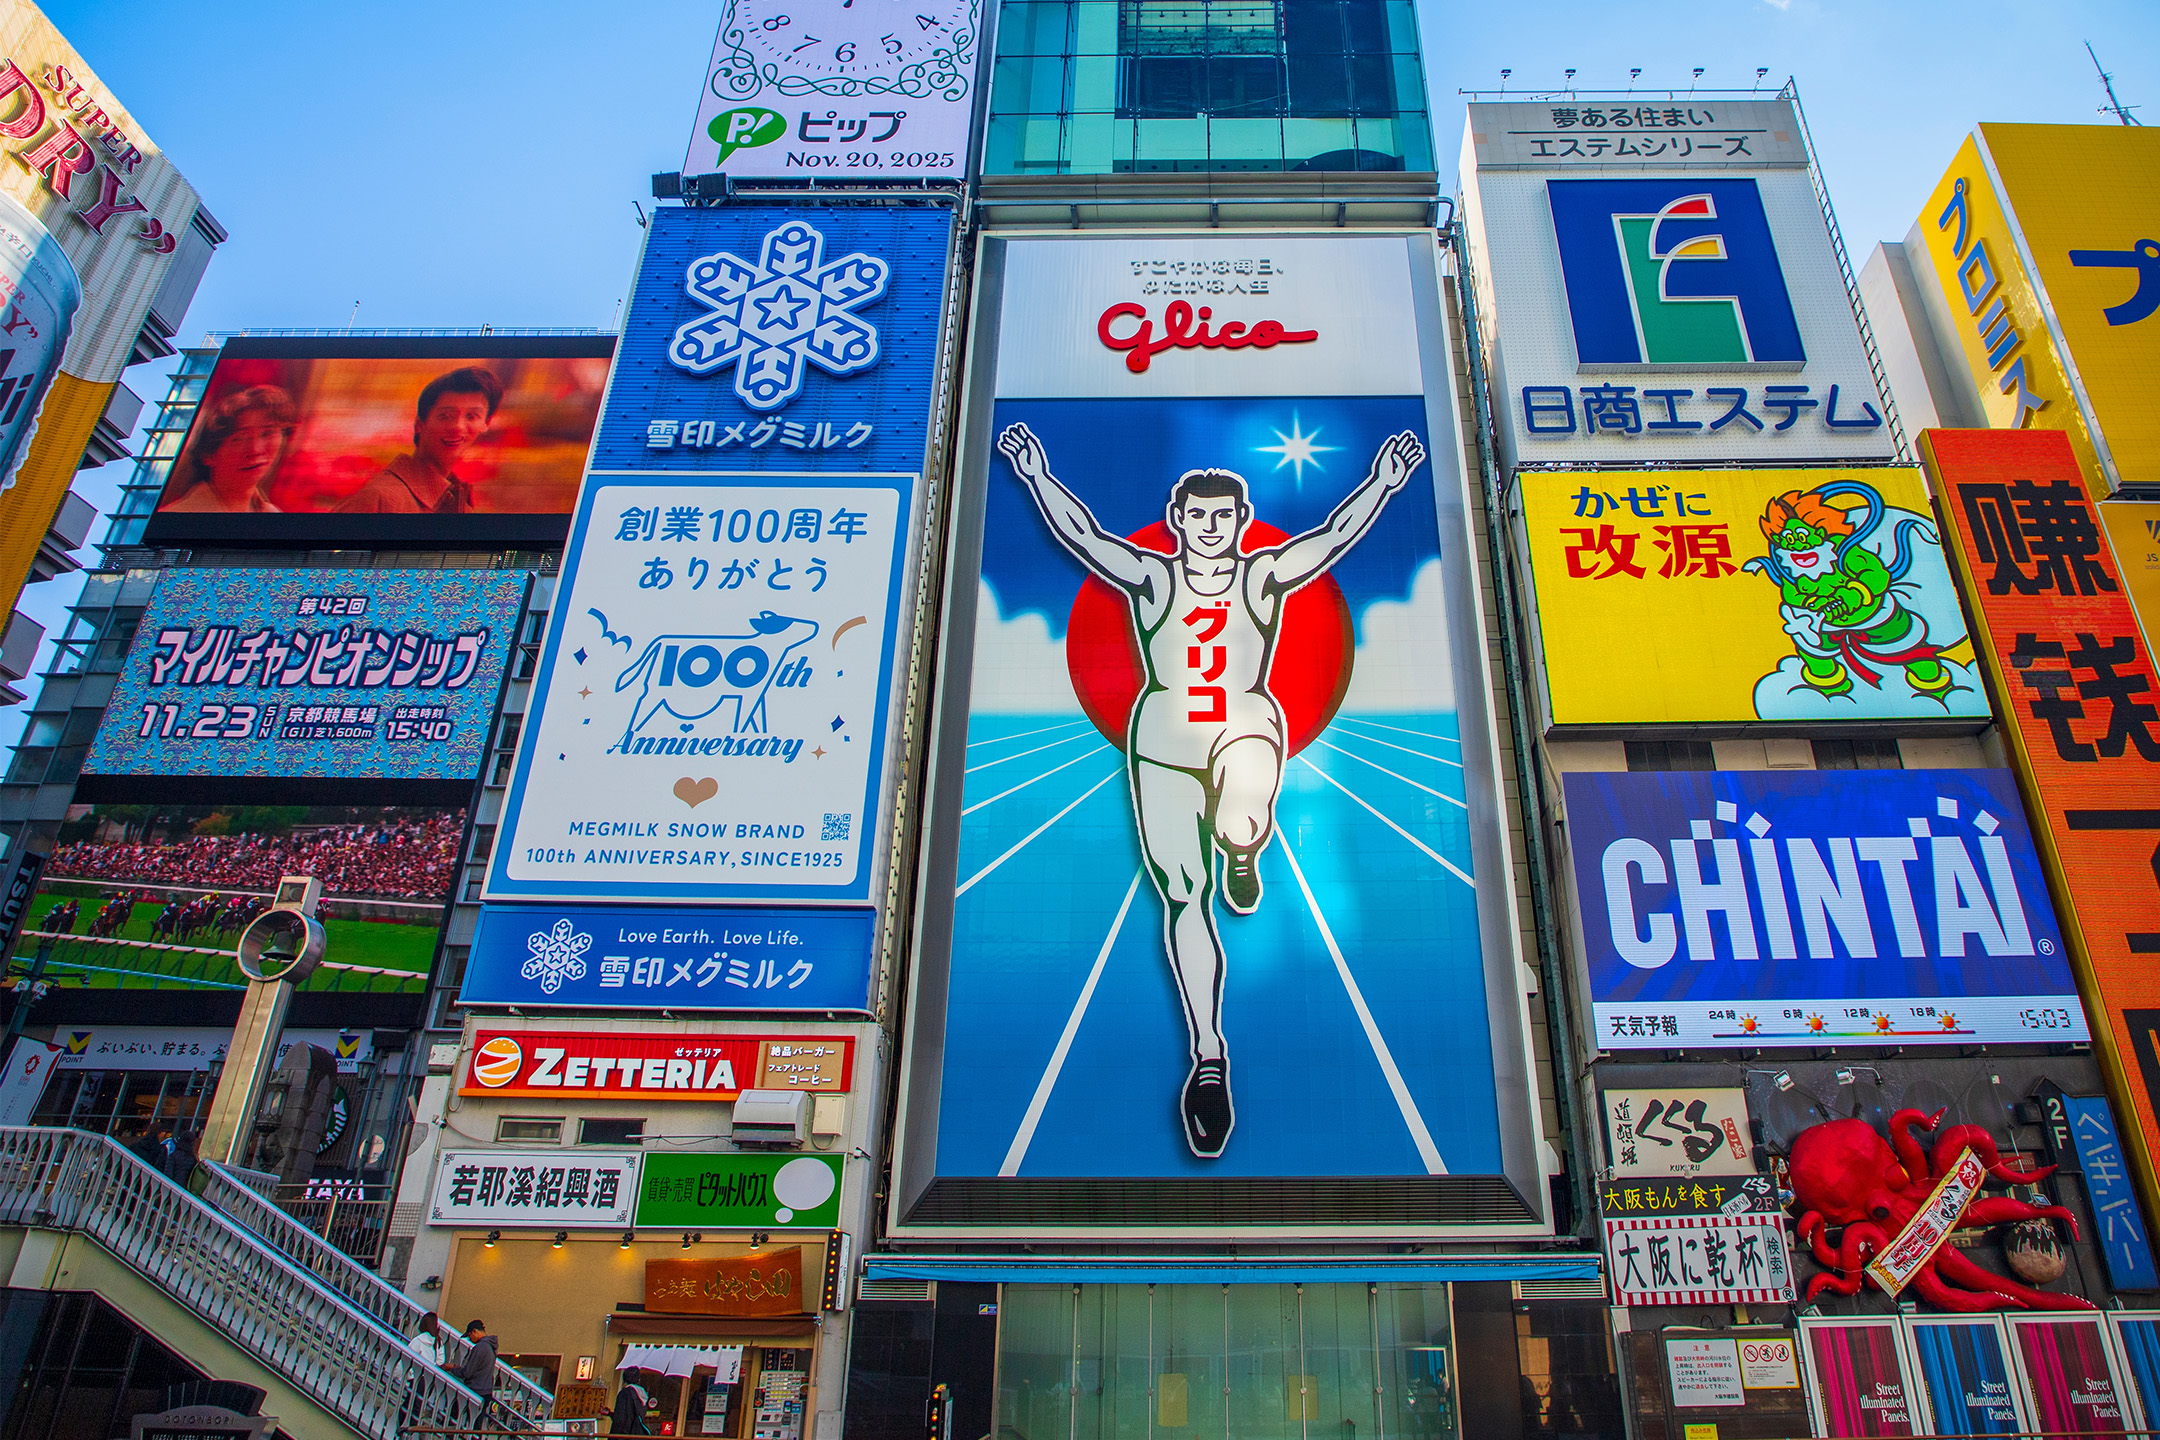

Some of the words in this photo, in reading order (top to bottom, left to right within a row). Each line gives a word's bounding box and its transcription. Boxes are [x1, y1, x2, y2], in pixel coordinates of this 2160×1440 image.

[762, 15, 791, 31] 8
[916, 14, 940, 31] 4
[793, 34, 822, 53] 7
[881, 33, 903, 54] 5
[835, 43, 856, 62] 6
[44, 64, 142, 175] SUPER
[798, 110, 907, 143] ピップ
[1551, 107, 1714, 129] 夢ある住まい
[1530, 135, 1752, 158] エステムシリーズ
[785, 152, 839, 168] Nov.
[846, 152, 884, 169] 20,
[890, 152, 955, 168] 2025
[1130, 259, 1284, 276] すこやかな毎日、
[1142, 280, 1270, 295] ゆたかな人生
[1938, 177, 2048, 429] プロミス
[1522, 383, 1883, 435] 日商エステム
[646, 416, 874, 451] 雪印メグミルク
[1571, 484, 1712, 519] かぜに
[614, 505, 868, 544] 創業100周年
[1559, 522, 1739, 581] 改源
[638, 556, 828, 592] ありがとう
[298, 597, 367, 615] 第42回
[153, 627, 487, 688] マイルチャンピオンシップ
[658, 643, 814, 689] 100th
[1182, 601, 1232, 723] グリコ
[140, 704, 257, 738] 11.23
[258, 705, 277, 738] SUN
[286, 706, 378, 724] 京都競馬場
[395, 707, 445, 719] 出走時刻
[388, 721, 452, 740] 15:40
[606, 729, 805, 764] Anniversary
[568, 821, 658, 837] MEGMILK
[667, 822, 728, 838] SNOW
[735, 823, 806, 840] BRAND
[526, 848, 576, 864] 100th
[618, 928, 657, 943] Love
[662, 928, 715, 944] Earth.
[723, 929, 763, 945] Love
[767, 930, 804, 946] Life.
[600, 952, 814, 989] 雪印メグミルク
[1708, 1010, 1736, 1020] 24時
[1783, 1009, 1803, 1019] 6時
[1843, 1008, 1870, 1018] 12時
[1909, 1006, 1936, 1017] 18時
[2019, 1008, 2072, 1029] 15:03
[1609, 1015, 1680, 1037] 天気予報
[674, 1047, 722, 1058] ゼッテリア
[770, 1045, 836, 1058] 絶品バーガー
[527, 1048, 737, 1090] ZETTERIA
[768, 1064, 822, 1074] フェアトレード
[788, 1075, 833, 1086] コーヒー
[1635, 1098, 1725, 1164] くくる
[2047, 1097, 2068, 1150] 2F
[1669, 1163, 1701, 1172] KUKRU
[697, 1171, 768, 1208] ピタットハウス
[1604, 1183, 1726, 1211] 大阪もんを食す
[1754, 1196, 1775, 1212] 2F
[1618, 1229, 1764, 1289] 大阪に乾杯
[1766, 1236, 1784, 1275] 検索
[1875, 1382, 1901, 1396] Street
[1981, 1379, 2007, 1394] Street
[2085, 1377, 2111, 1392] Street
[1881, 1409, 1910, 1423] Panels.
[1987, 1407, 2017, 1421] Panels.
[2092, 1404, 2122, 1418] Panels.
